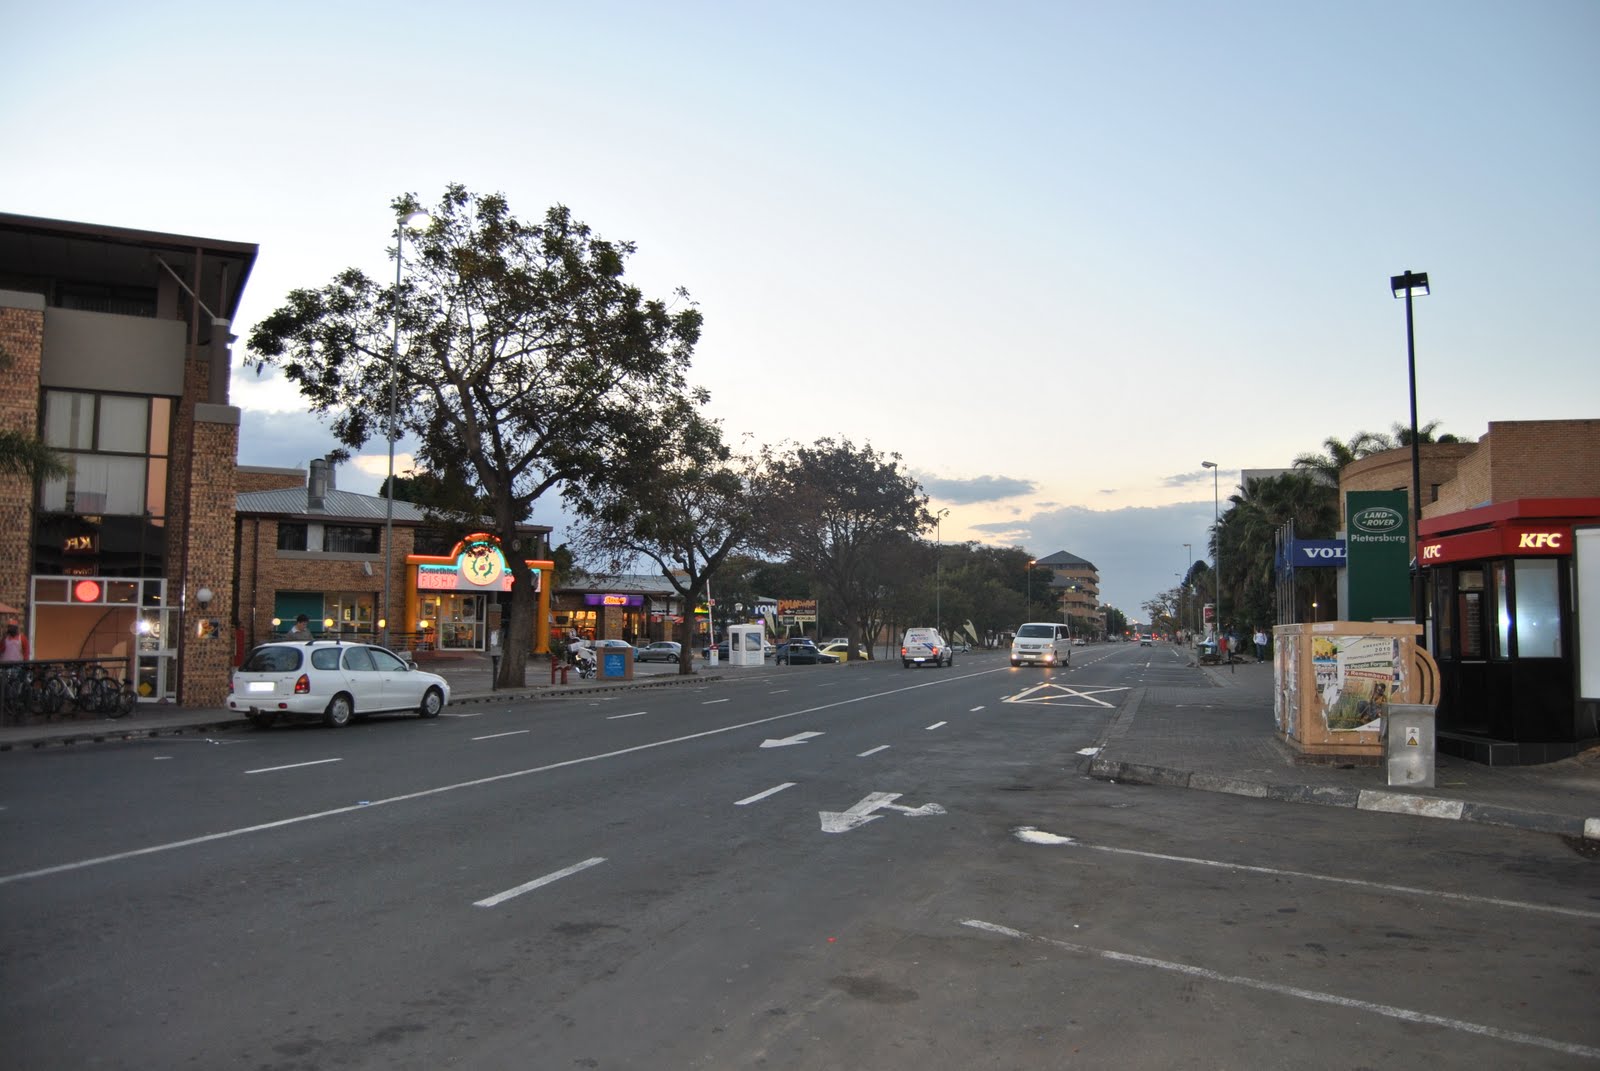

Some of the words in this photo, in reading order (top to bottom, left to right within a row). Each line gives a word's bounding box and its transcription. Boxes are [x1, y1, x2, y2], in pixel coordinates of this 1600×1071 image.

[1351, 534, 1406, 543] Pietersburg
[1519, 533, 1562, 548] KFC
[1423, 544, 1441, 559] KFC
[420, 566, 457, 576] Something
[421, 575, 456, 587] FISHY
